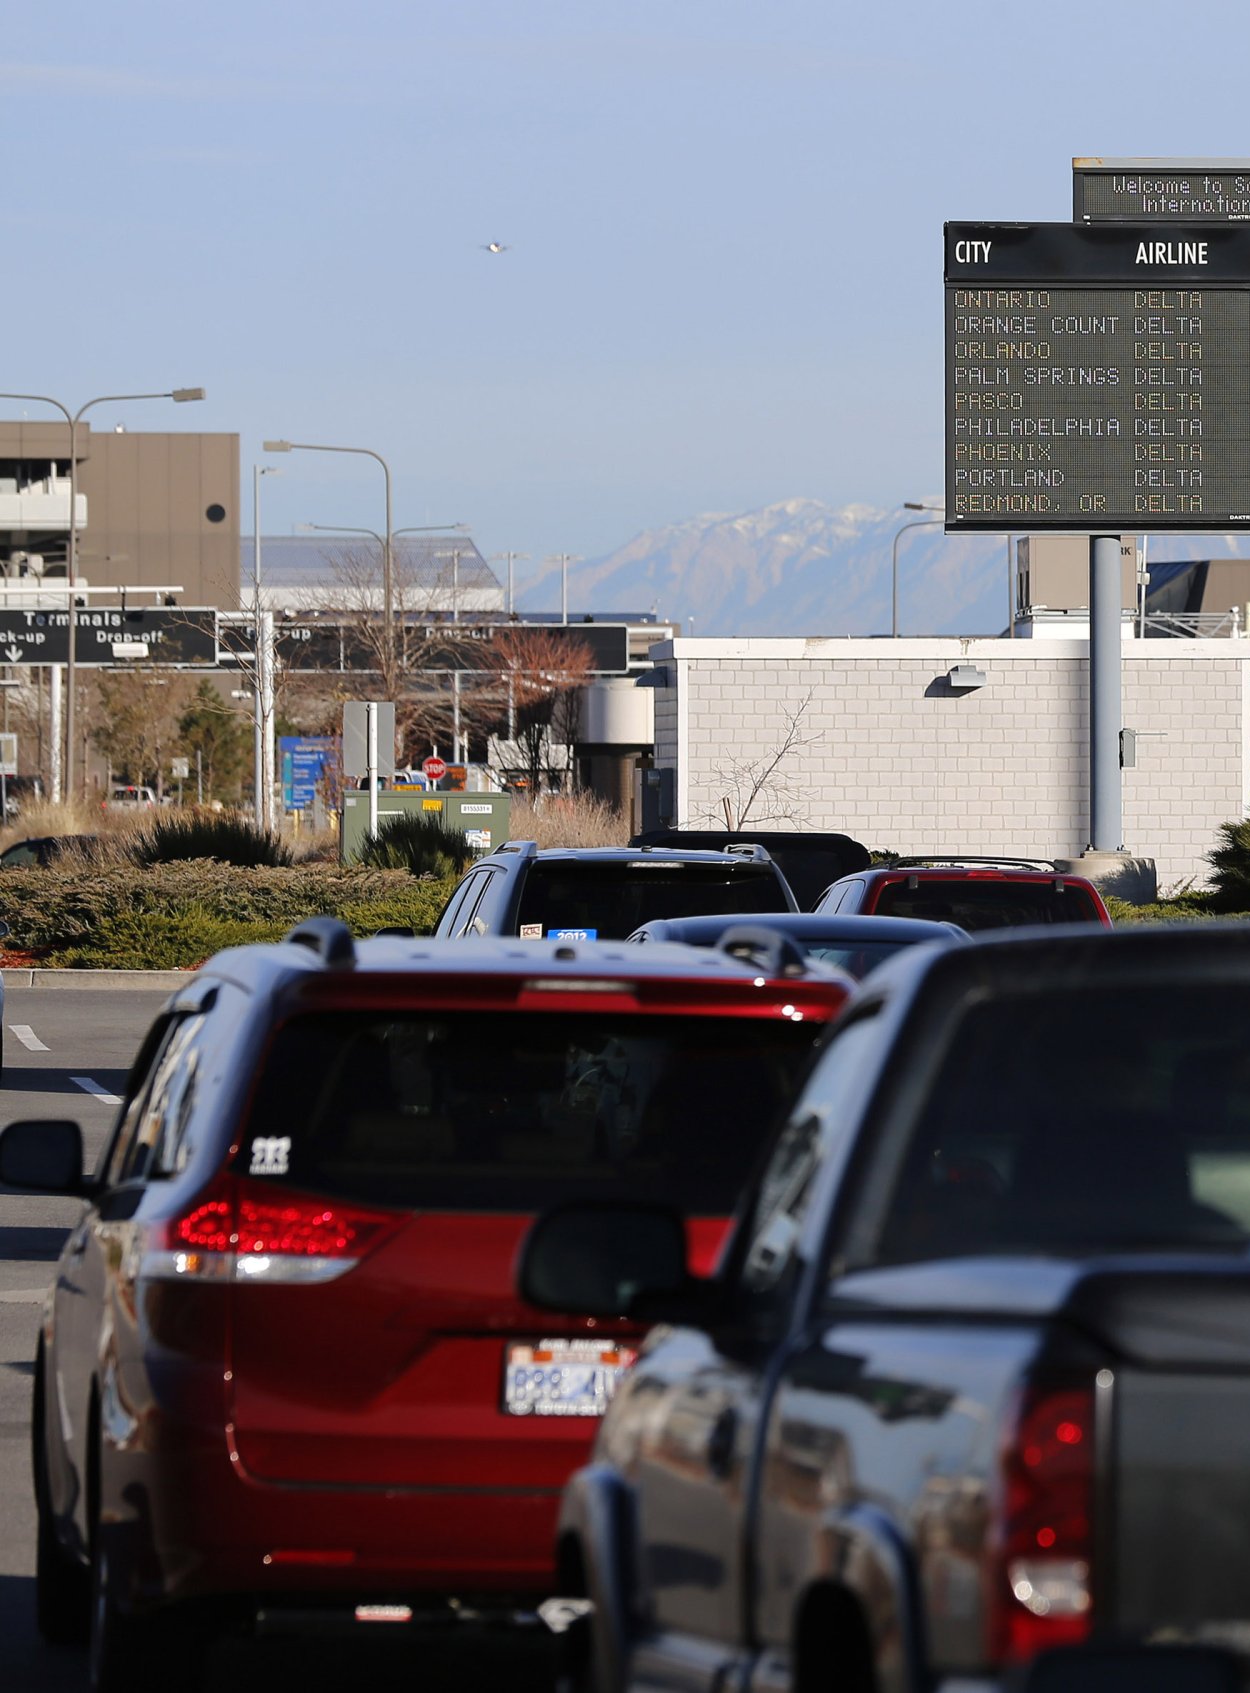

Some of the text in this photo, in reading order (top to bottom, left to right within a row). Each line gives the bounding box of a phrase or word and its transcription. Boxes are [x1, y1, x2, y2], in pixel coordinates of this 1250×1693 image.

[1113, 176, 1189, 194] Welcome
[1202, 177, 1222, 194] to
[955, 241, 991, 263] CITY
[1135, 241, 1208, 264] AIRLINE
[955, 292, 1051, 309] ONTARIO
[1134, 292, 1202, 309] DELTA
[955, 317, 1036, 334] ORANGE
[1051, 317, 1119, 334] COUNT
[1134, 317, 1202, 334] DELTA
[955, 343, 1051, 360] ORLANDO
[1134, 343, 1202, 360] DELTA
[955, 368, 1009, 385] PALM
[1024, 368, 1119, 385] SPRINGS
[1134, 368, 1202, 385] DELTA
[955, 393, 1023, 411] PASCO
[1134, 393, 1202, 411] DELTA
[955, 419, 1120, 436] PHILADELPHIA
[1134, 419, 1202, 436] DELTA
[955, 444, 1051, 461] PHOENIX
[1134, 444, 1202, 461] DELTA
[955, 470, 1064, 487] PORTLAND
[1134, 470, 1202, 487] DELTA
[955, 495, 1061, 512] REDMOND,
[1079, 495, 1106, 512] OR
[1134, 495, 1202, 512] DELTA
[24, 611, 121, 626] Terminals
[424, 763, 445, 774] STOP
